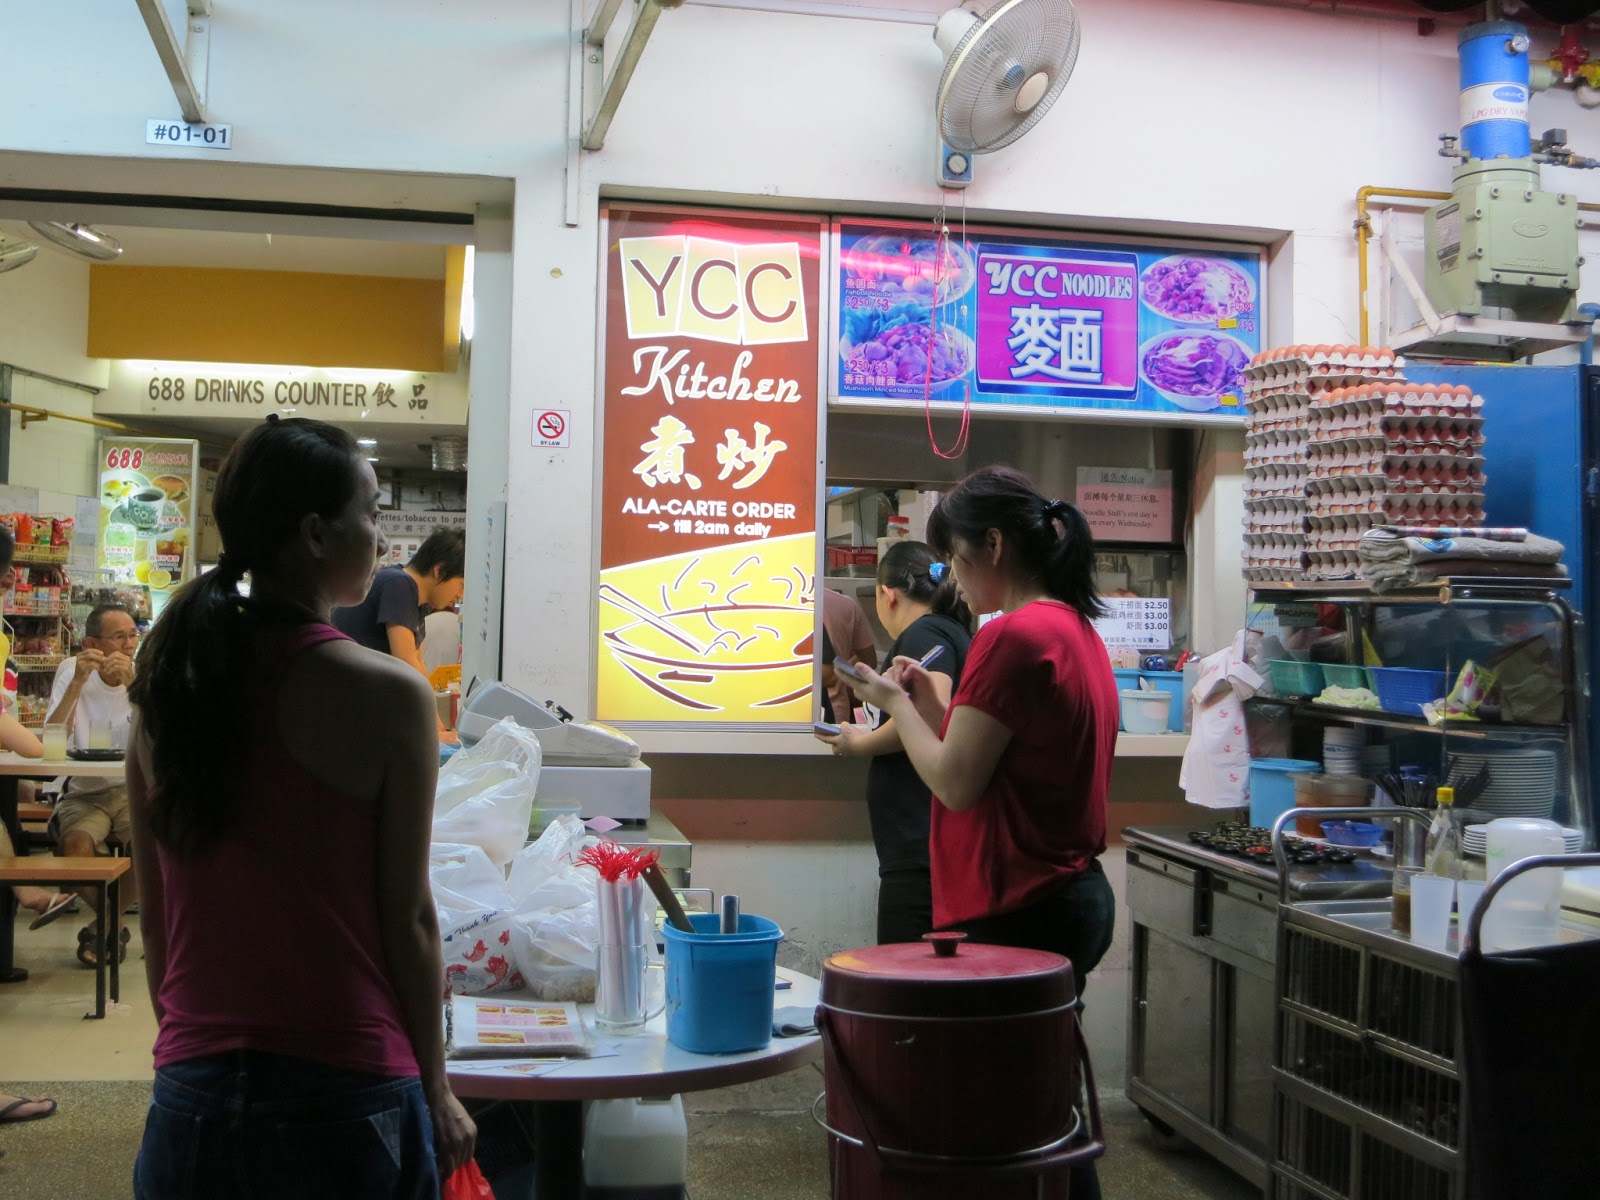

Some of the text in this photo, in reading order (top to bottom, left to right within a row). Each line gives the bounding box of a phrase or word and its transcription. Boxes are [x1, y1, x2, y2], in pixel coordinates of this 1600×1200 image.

[154, 124, 227, 144] #01-01
[629, 255, 797, 323] YCC
[984, 261, 1133, 300] YCC NOODLES
[870, 290, 892, 298] Noodle
[620, 345, 802, 405] Kitchen
[149, 377, 367, 407] 688 DRINKS COUNTER
[372, 381, 429, 410] 飲品
[106, 447, 144, 470] 688
[632, 415, 788, 490] 煮炒
[622, 497, 796, 519] ALA-CARTE ORDER
[1140, 511, 1151, 520] day
[441, 515, 449, 523] to
[673, 519, 771, 538] till 2am daily
[1098, 520, 1116, 528] every
[1144, 601, 1168, 610] $2.50
[1144, 612, 1168, 620] $3.00
[1144, 622, 1168, 630] $3.00
[454, 910, 498, 935] Thank You
